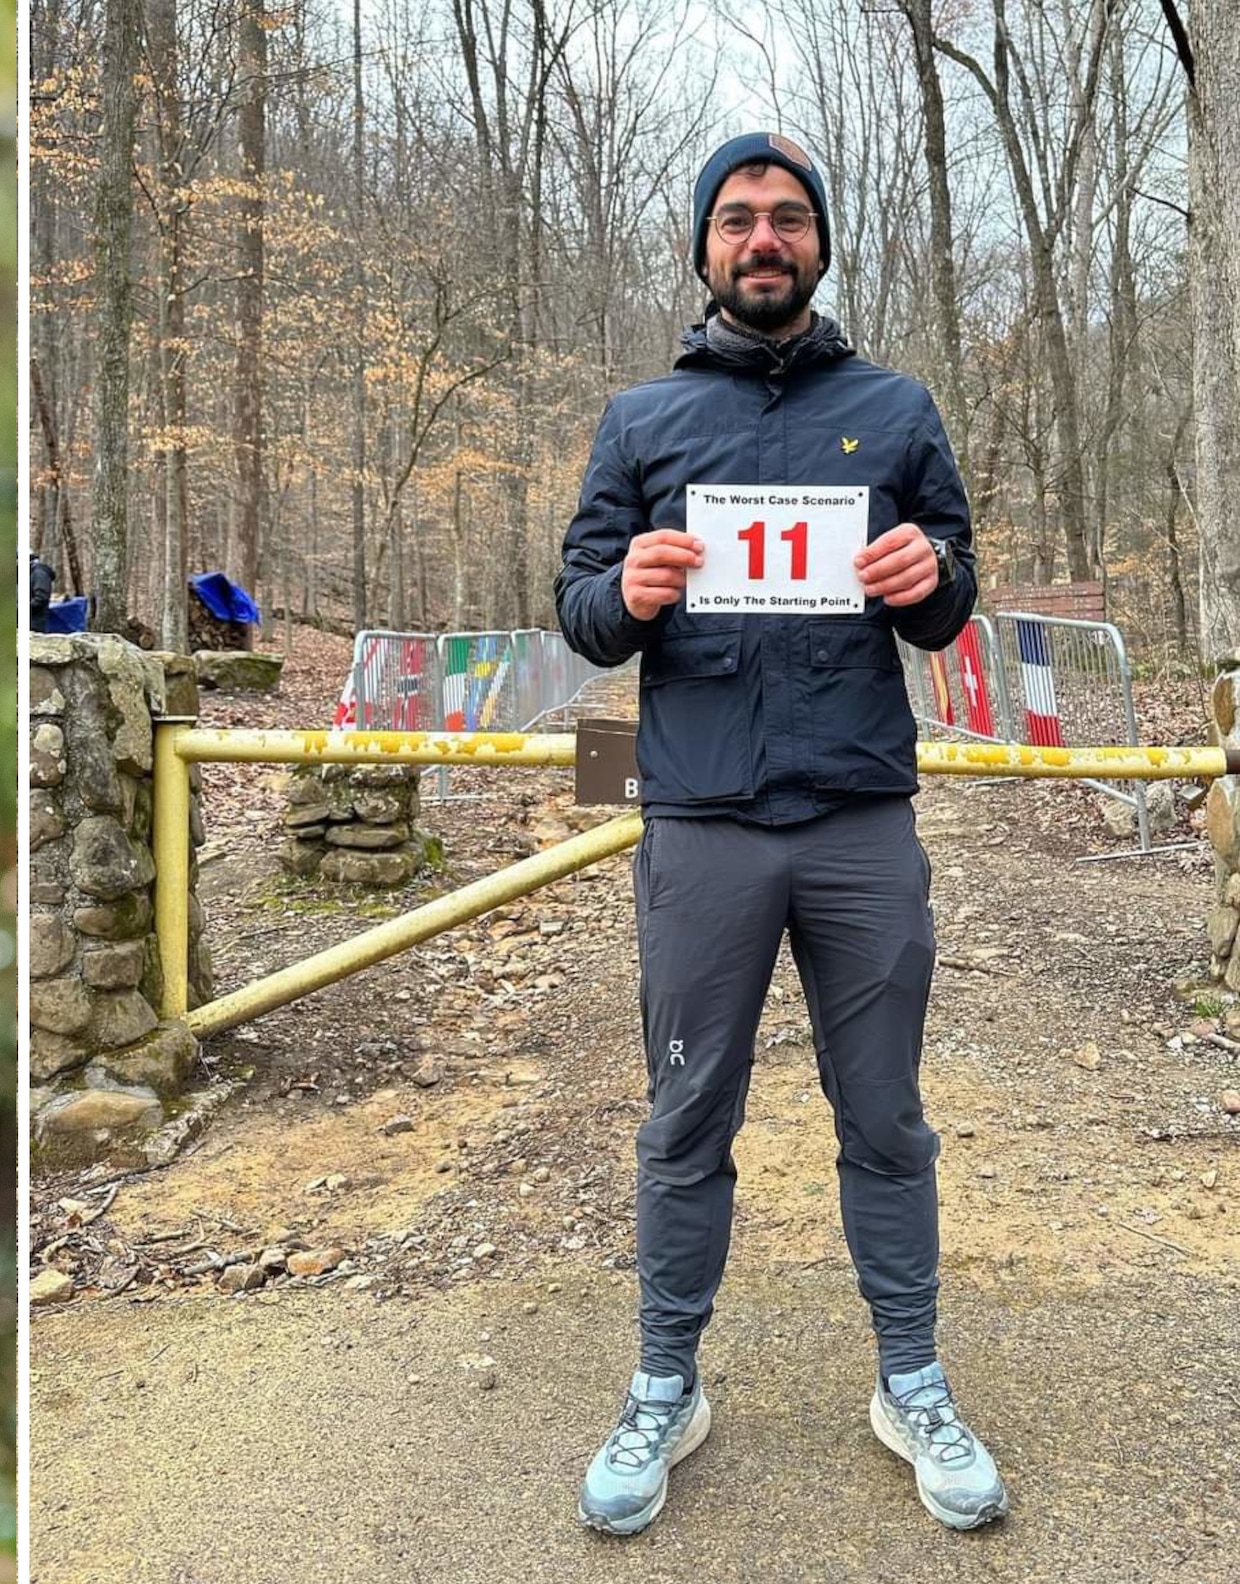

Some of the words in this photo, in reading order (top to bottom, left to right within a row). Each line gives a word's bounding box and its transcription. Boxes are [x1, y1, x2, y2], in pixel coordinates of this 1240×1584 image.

[703, 494, 727, 505] The
[730, 494, 765, 505] Worst
[768, 495, 799, 506] Case
[802, 494, 856, 506] Scenario
[737, 521, 808, 580] 11
[699, 595, 711, 606] Is
[713, 595, 740, 607] Only
[743, 595, 767, 606] The
[769, 596, 817, 608] Starting
[820, 596, 851, 606] Point
